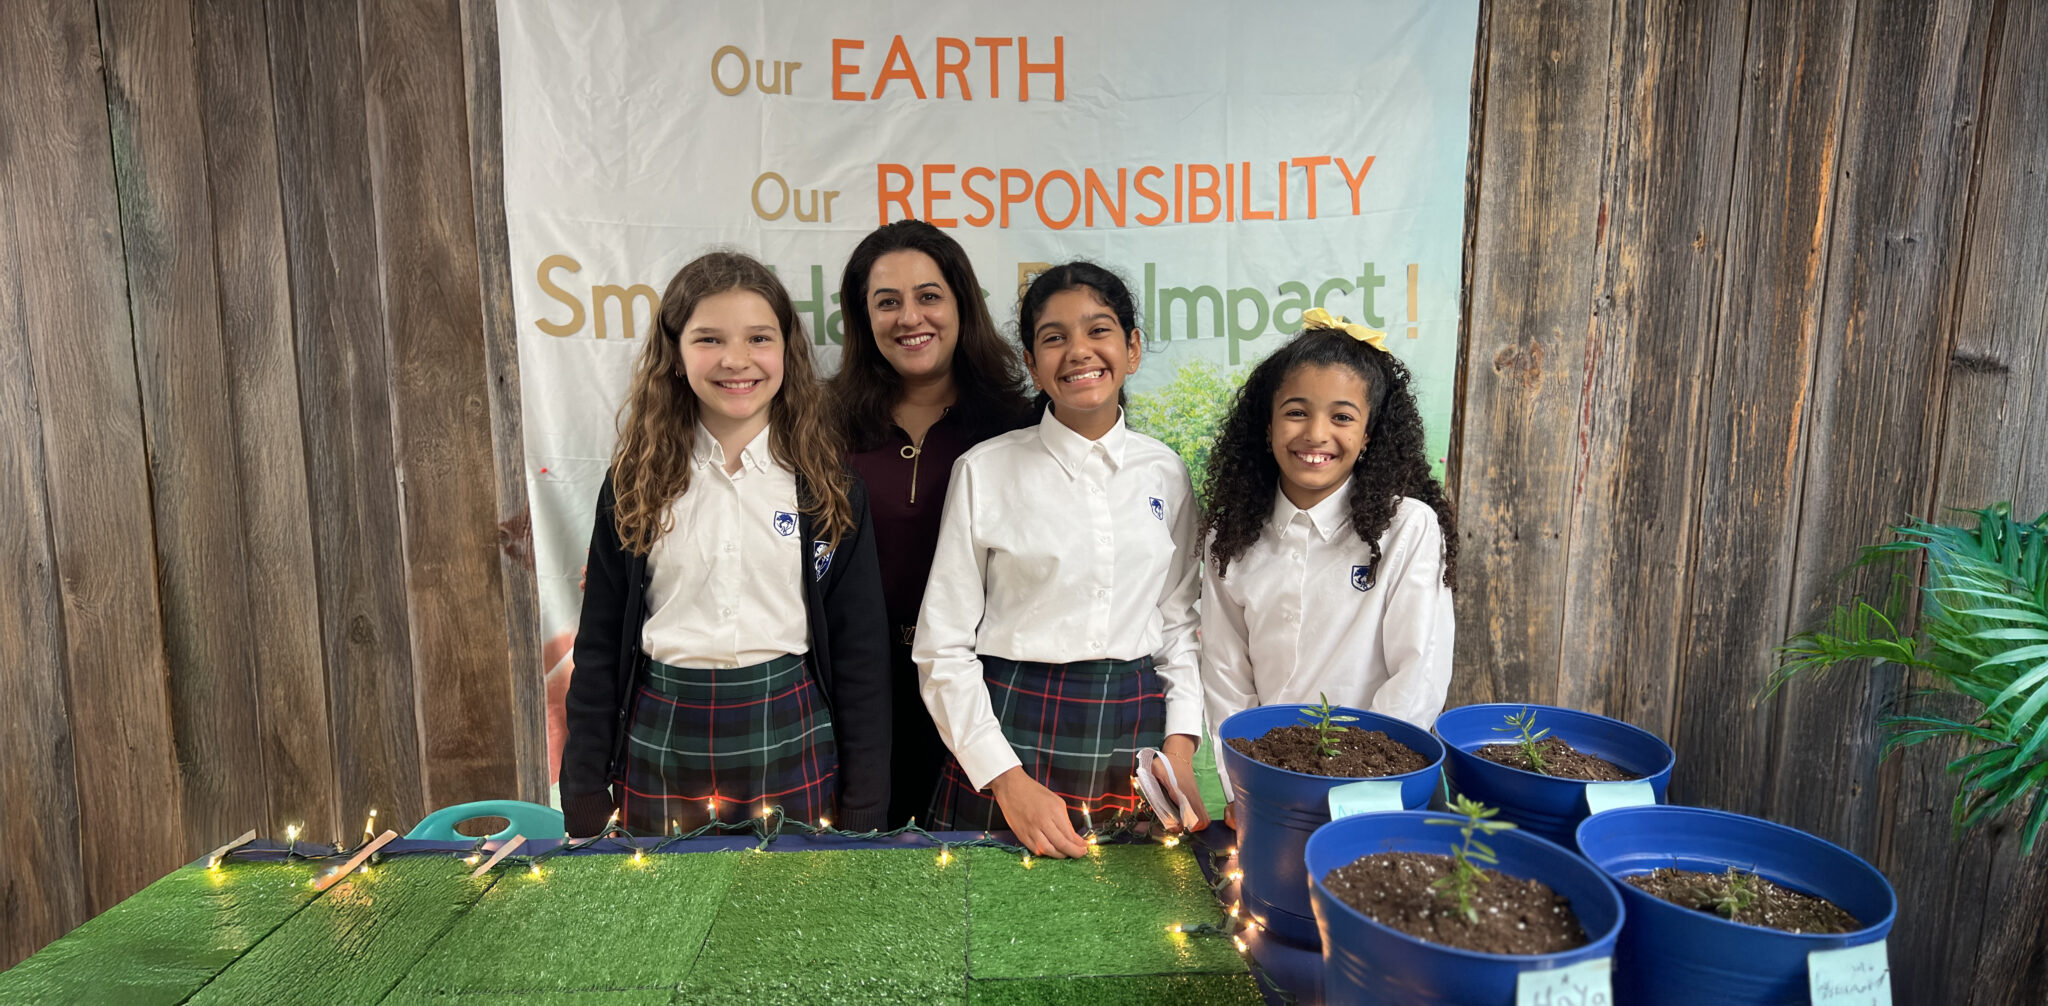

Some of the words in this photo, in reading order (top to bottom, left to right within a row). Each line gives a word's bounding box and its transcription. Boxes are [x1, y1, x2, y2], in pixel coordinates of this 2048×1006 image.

[711, 45, 802, 96] Our
[832, 35, 1065, 102] EARTH
[751, 171, 840, 223] Our
[877, 155, 1376, 231] RESPONSIBILITY
[1144, 262, 1386, 366] Impact
